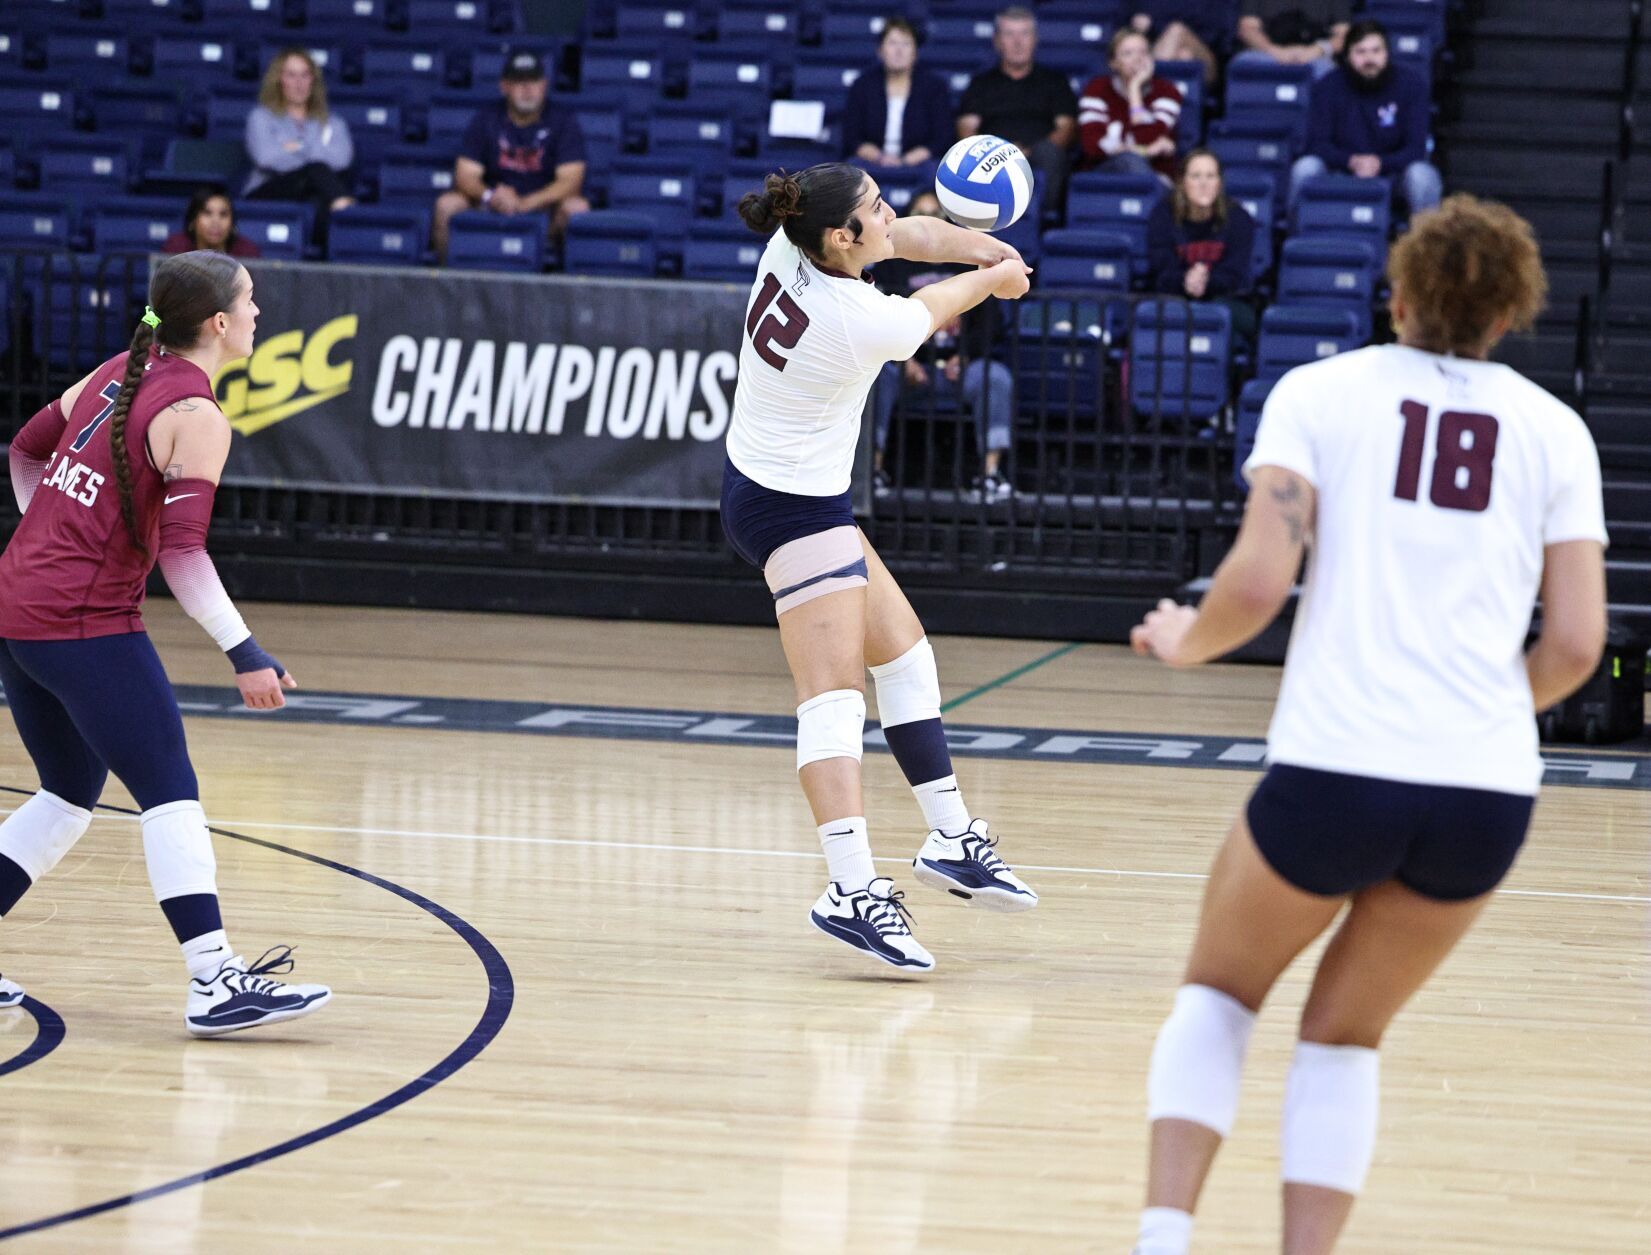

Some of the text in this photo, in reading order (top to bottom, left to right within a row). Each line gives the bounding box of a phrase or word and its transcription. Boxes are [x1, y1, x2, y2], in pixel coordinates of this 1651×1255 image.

[211, 312, 359, 420] GSC
[746, 272, 810, 372] 12
[371, 334, 738, 442] CHAMPIONS
[1393, 399, 1499, 512] 18
